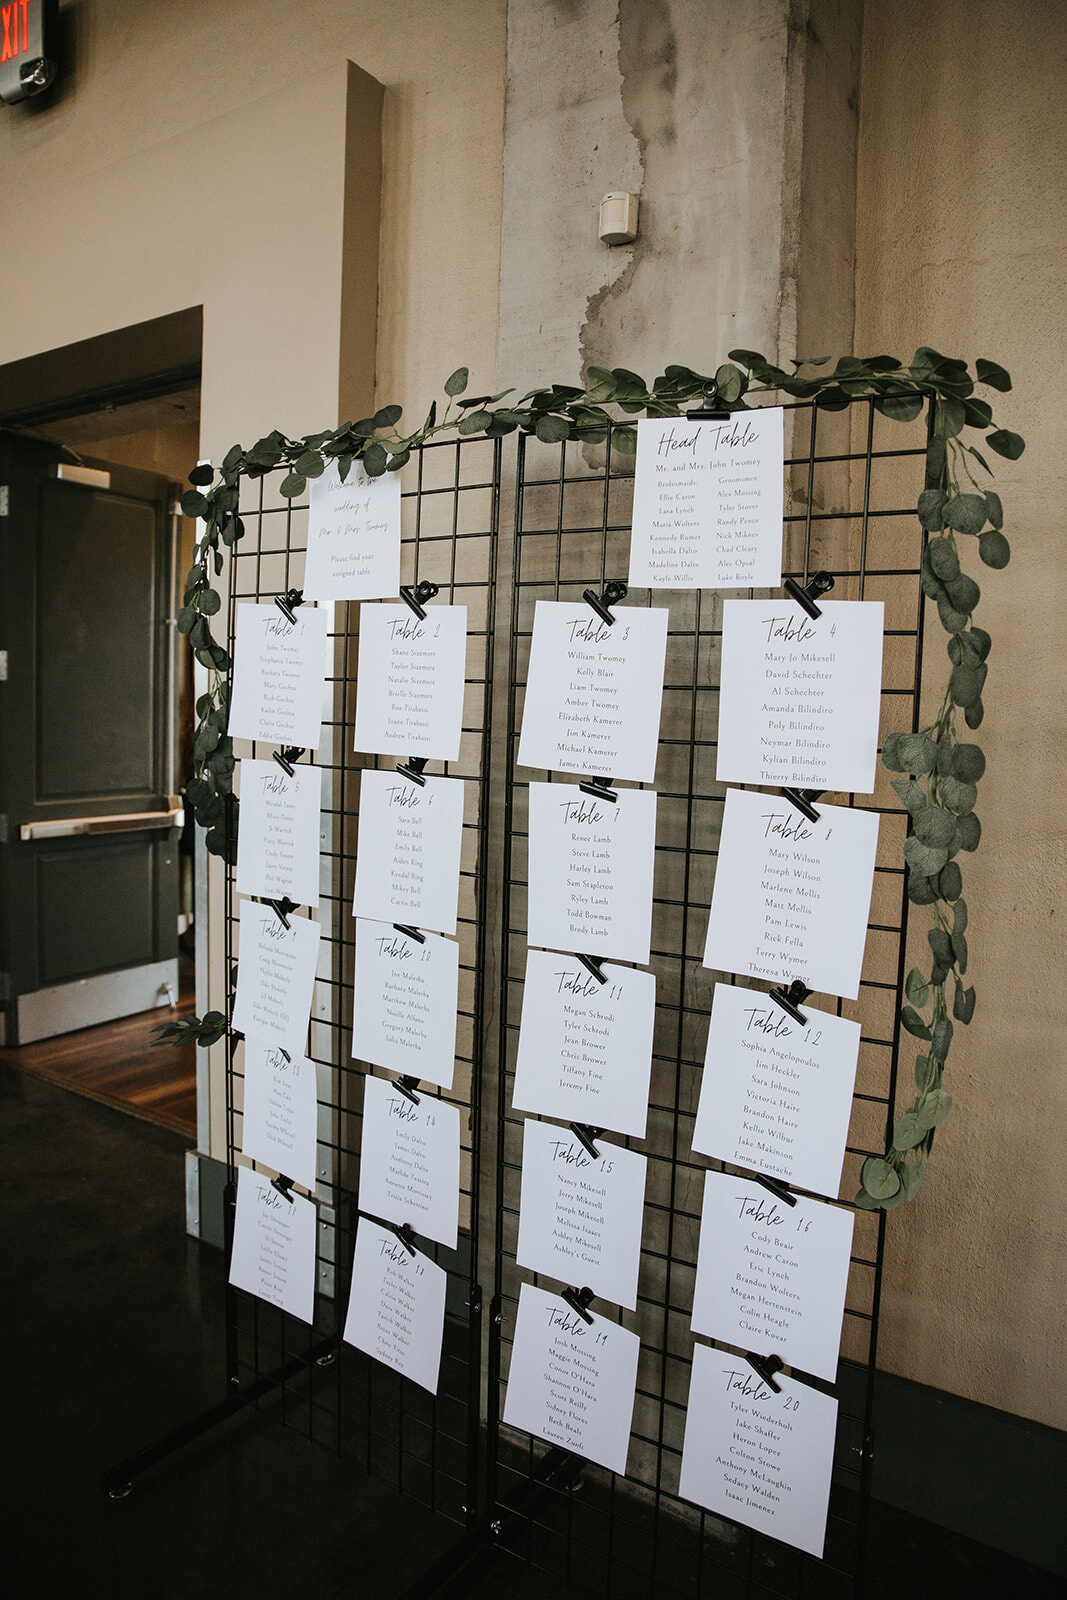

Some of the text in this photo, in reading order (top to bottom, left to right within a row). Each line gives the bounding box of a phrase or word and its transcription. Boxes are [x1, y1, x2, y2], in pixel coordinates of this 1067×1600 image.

[0, 0, 31, 63] XIT
[658, 421, 760, 458] Head Table
[672, 463, 686, 471] and
[689, 462, 707, 470] Mrs.
[710, 460, 727, 470] John
[730, 459, 760, 467] Twomey
[658, 479, 698, 488] Bridesmaids:
[718, 476, 760, 484] Groomsmen:
[717, 517, 737, 526] Randy
[331, 555, 348, 563] Please
[349, 553, 360, 561] find
[716, 545, 757, 553] Chad Cleary
[357, 567, 371, 575] table
[717, 572, 754, 582] Luke Boyle
[262, 617, 295, 637] Table
[387, 617, 441, 641] Table 2
[566, 618, 630, 643] Table 3
[762, 615, 837, 643] Table 4
[391, 648, 409, 656] Shane
[568, 651, 626, 664] William Twomey
[765, 653, 835, 663] Mary Jo Mikesell
[577, 667, 614, 678] Kelly Blair
[765, 669, 832, 679] David Schechter
[564, 697, 619, 711] Amber Twomey
[761, 703, 833, 714] Amanda Bilindiro
[558, 712, 623, 725] Elizabeth Kamerer
[557, 743, 617, 757] Michael Kamerer
[763, 754, 827, 766] Kylian Bilindiro
[760, 771, 827, 783] Thierry Bilindiro
[386, 785, 422, 808] Table
[560, 800, 620, 825] Table 7
[761, 812, 813, 841] Table
[571, 833, 611, 843] Renee Lamb
[769, 848, 820, 864] Mary Wilson
[764, 864, 821, 882] Joseph Wilson
[410, 886, 421, 894] Bell
[566, 878, 613, 890] Sam Stapleton
[761, 881, 820, 899] Marlene Mellis
[566, 908, 612, 921] Todd Bowman
[765, 915, 807, 931] Pam Lewis
[570, 924, 608, 936] Brody Lamb
[764, 932, 803, 947] Rick Fella
[375, 937, 431, 961] Table 10
[554, 971, 623, 1000] Table 11
[564, 1005, 615, 1022] Megan Schrodi
[564, 1020, 609, 1036] Tyler Schrodi
[744, 1008, 822, 1046] Table 12
[564, 1035, 606, 1050] Jean Brower
[741, 1039, 820, 1069] Sophia Angelopoulos
[562, 1064, 603, 1080] Tiffany Fine
[751, 1074, 800, 1096] Sara Johnson
[386, 1098, 419, 1122] Table
[747, 1089, 800, 1113] Victoria Haire
[743, 1121, 794, 1144] Kellie Wilbur
[550, 1141, 615, 1173] Table 15
[738, 1136, 793, 1160] Jake Makinson
[734, 1151, 792, 1176] Emma Eustache
[557, 1174, 606, 1196] Nancy Mikesell
[735, 1196, 812, 1232] Table 16
[557, 1216, 601, 1238] Melissa Isaacs
[751, 1231, 794, 1250] Cody Beair
[378, 1239, 409, 1266] Table
[553, 1243, 600, 1266] Ashley's Guest
[750, 1261, 789, 1281] Eric Lynch
[736, 1273, 800, 1300] Brandon Wolters
[731, 1286, 802, 1317] Megan Hertenstein
[546, 1307, 608, 1346] Table 19
[739, 1320, 787, 1342] Claire Kovar
[554, 1337, 596, 1362] Josh Mossing
[544, 1373, 597, 1402] Shannon O'Hara
[723, 1370, 800, 1411] Table 20
[550, 1389, 587, 1412] Scott Reilly
[730, 1401, 793, 1432] Tyler Wiederholt
[715, 1455, 748, 1475] Anthony
[729, 1446, 781, 1472] Colton Stowe
[723, 1473, 780, 1502] Sedacy Walden
[725, 1489, 775, 1515] Isaac Jimenez
